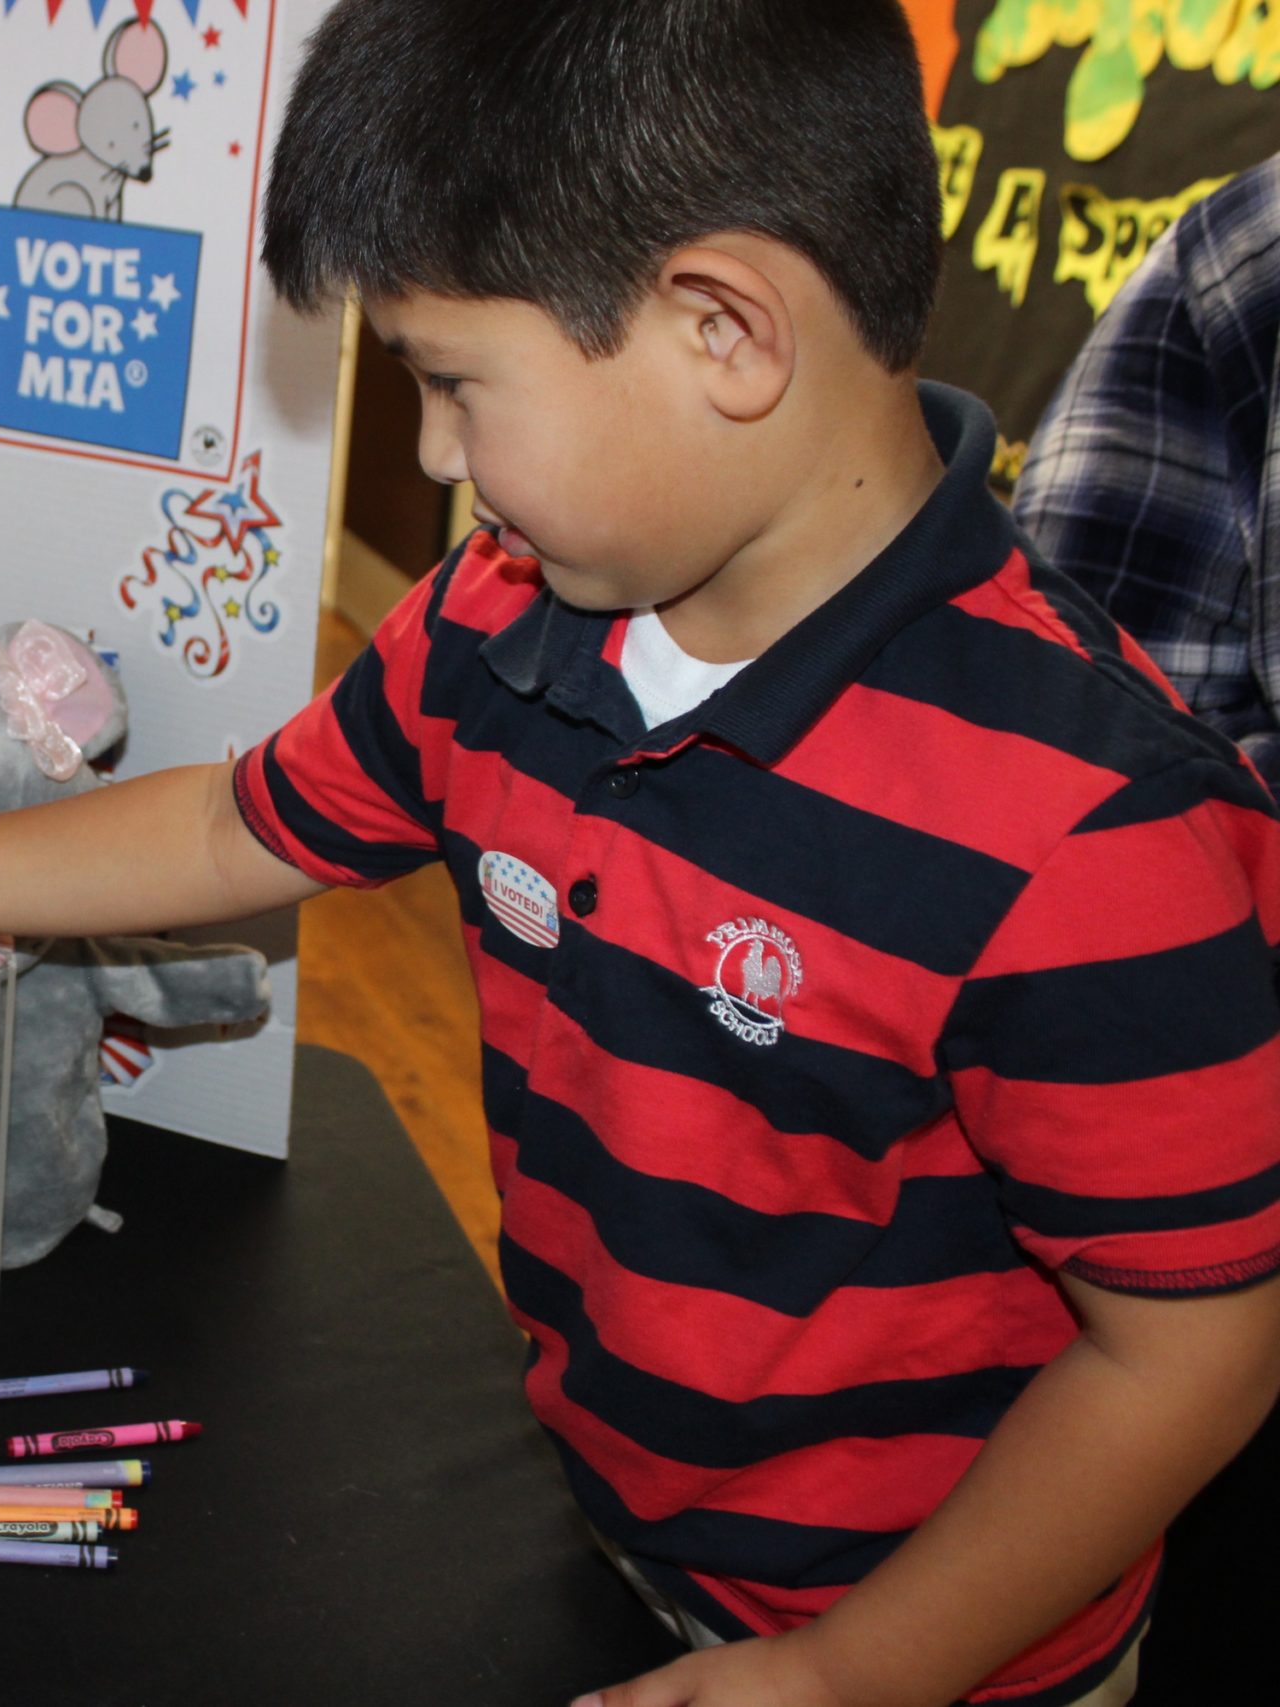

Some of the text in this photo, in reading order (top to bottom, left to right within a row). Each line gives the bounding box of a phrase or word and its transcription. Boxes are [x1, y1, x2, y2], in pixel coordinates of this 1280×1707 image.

[15, 237, 141, 299] VOTE
[24, 295, 125, 355] FOR
[500, 882, 544, 918] VOTED!
[57, 1431, 112, 1449] Crayola
